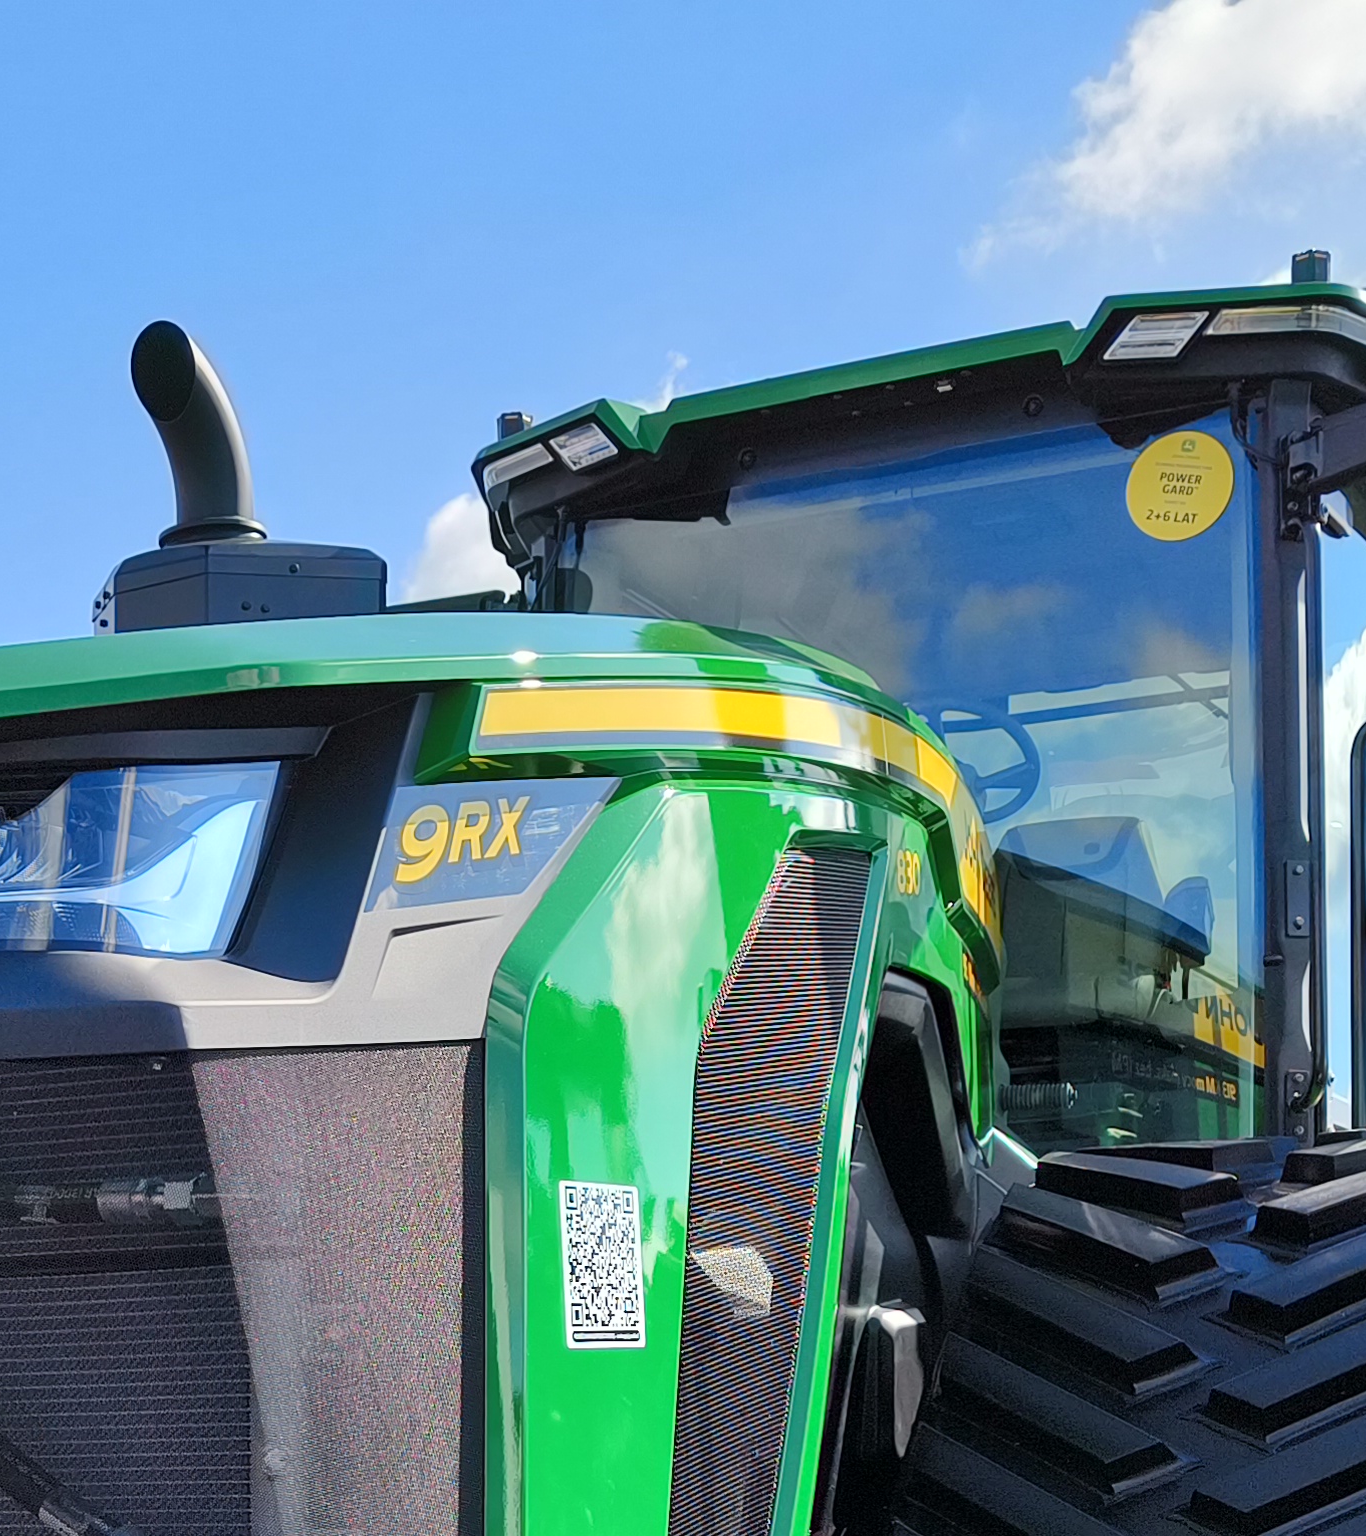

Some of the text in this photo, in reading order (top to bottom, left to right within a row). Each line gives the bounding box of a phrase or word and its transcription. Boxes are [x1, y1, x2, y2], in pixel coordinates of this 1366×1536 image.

[1159, 472, 1203, 485] POWER
[1146, 509, 1199, 524] 2+6 LAT
[395, 796, 531, 883] 9RX
[897, 850, 921, 896] 830
